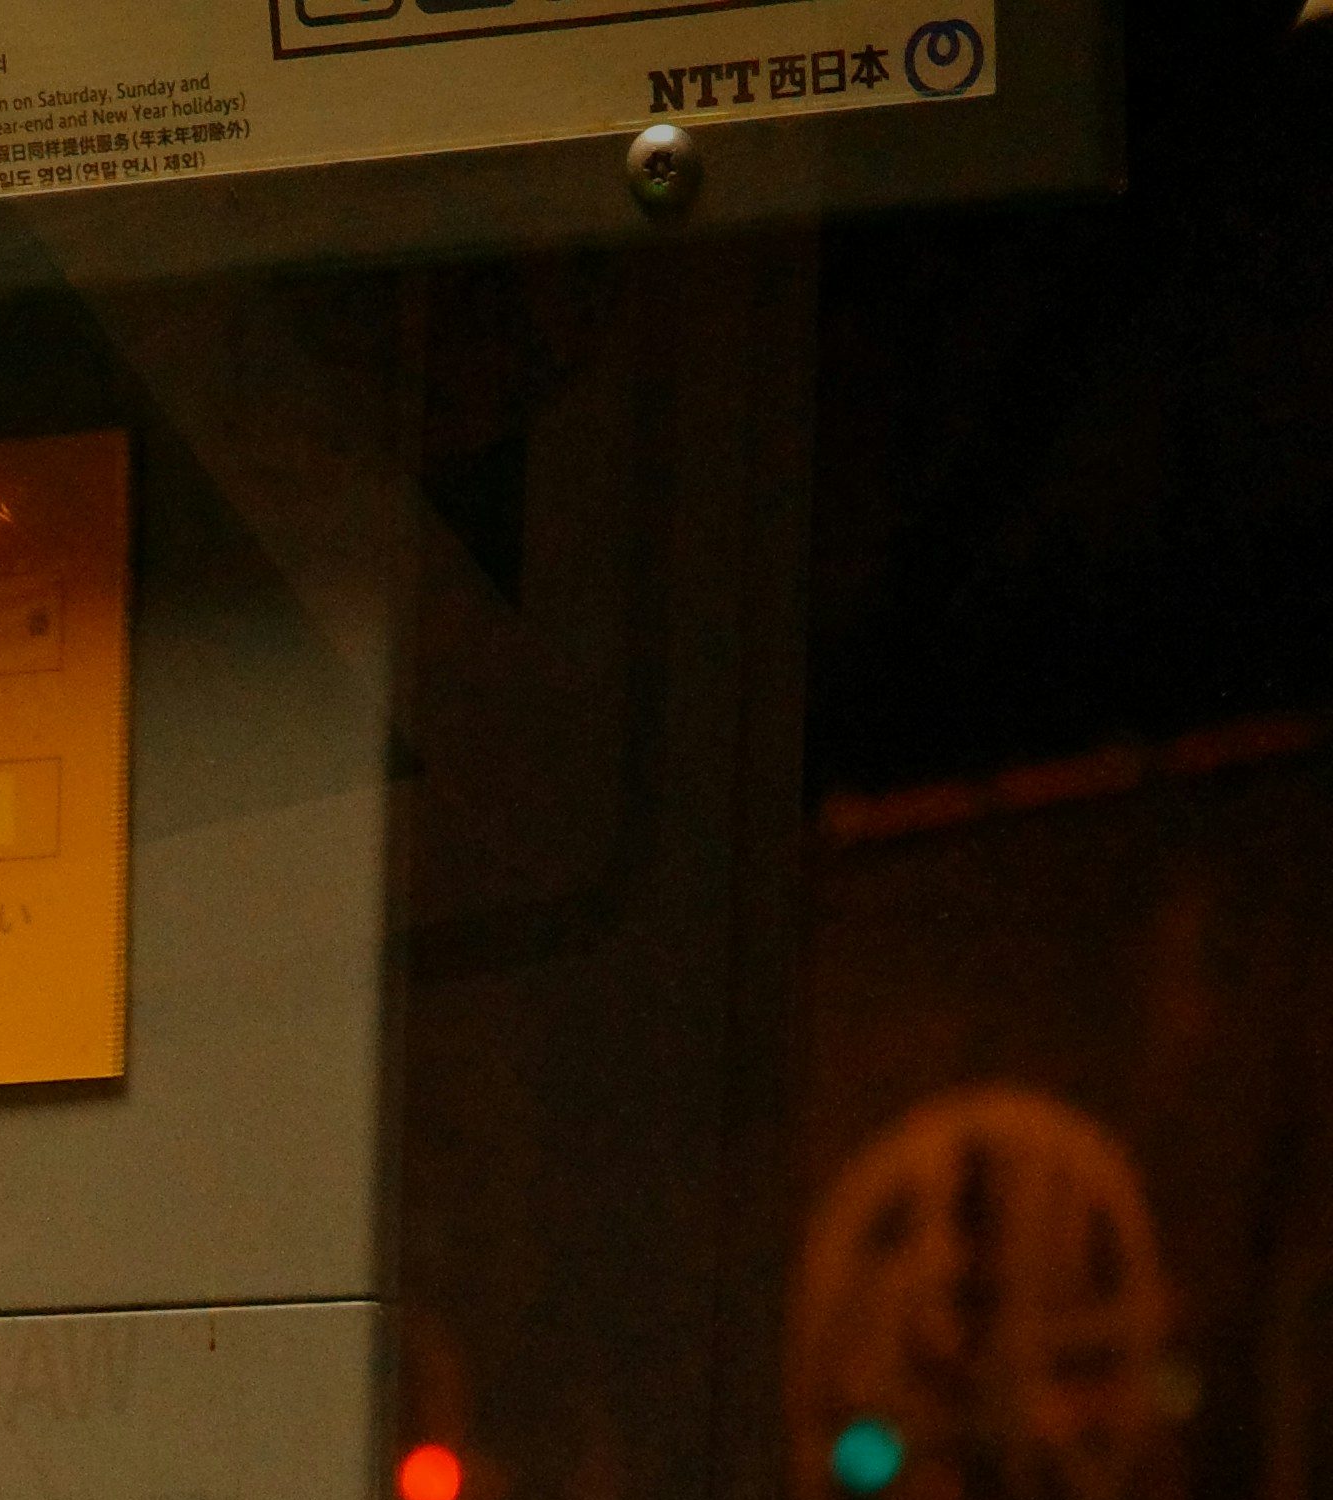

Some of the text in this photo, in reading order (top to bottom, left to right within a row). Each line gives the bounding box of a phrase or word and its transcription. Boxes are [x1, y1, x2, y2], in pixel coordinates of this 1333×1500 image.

[13, 95, 33, 111] on
[38, 86, 113, 108] Saturday,
[117, 79, 175, 100] Sunday
[180, 73, 210, 92] and
[648, 46, 890, 114] NTT西日本
[59, 110, 88, 129] and
[93, 107, 127, 126] New
[132, 103, 167, 122] Year
[172, 92, 247, 117] holidays)
